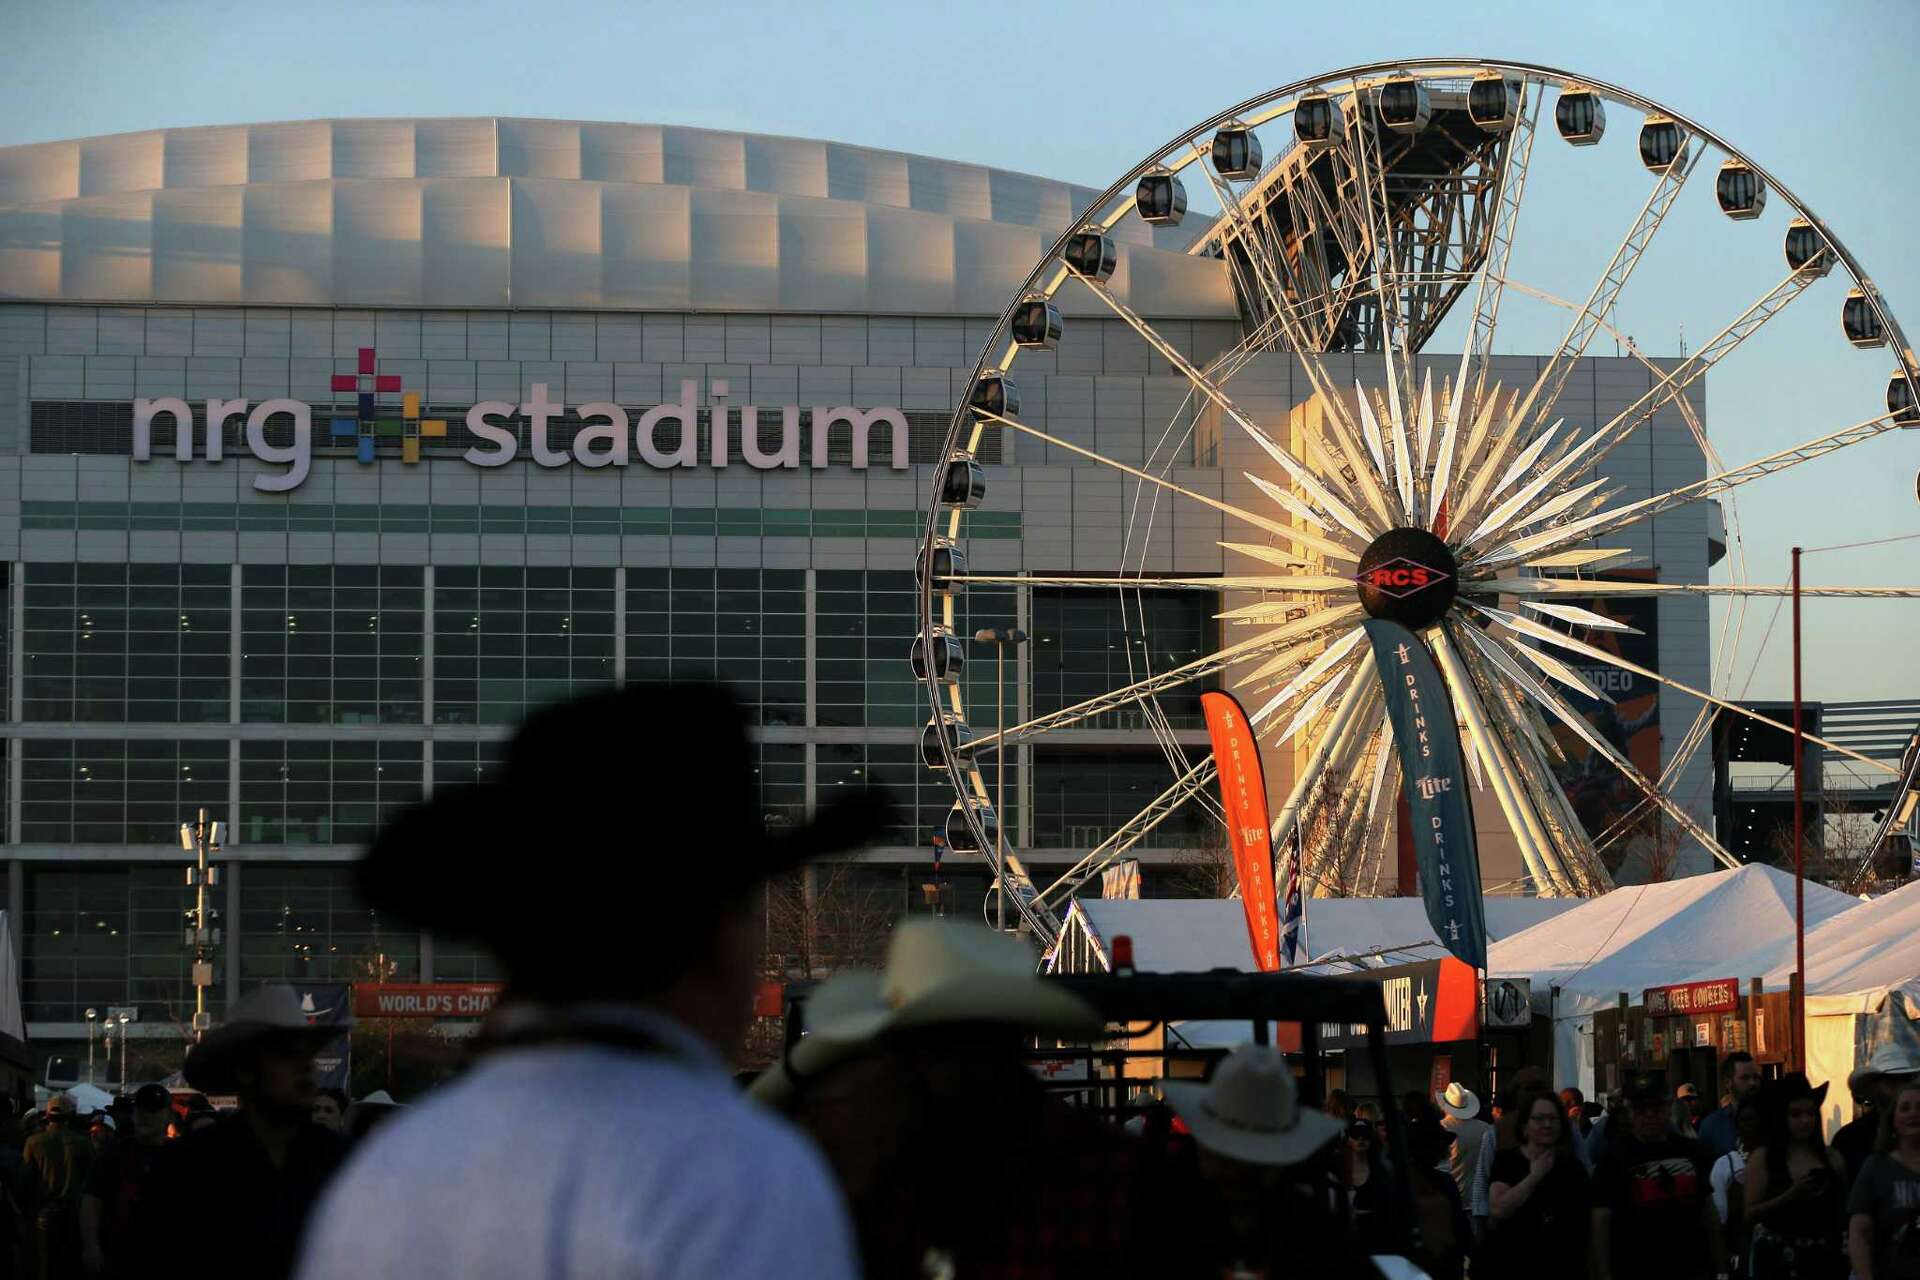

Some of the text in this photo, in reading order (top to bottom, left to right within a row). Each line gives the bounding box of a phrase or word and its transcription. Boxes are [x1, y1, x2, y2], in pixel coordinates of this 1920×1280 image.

[131, 379, 909, 492] nrg stadium
[1371, 568, 1429, 586] RCS
[1581, 670, 1633, 692] ODEO
[1405, 674, 1430, 757] DRINKS
[1230, 737, 1249, 810] DRINKS
[1415, 775, 1451, 800] Lite
[1240, 825, 1265, 847] Lite
[1431, 816, 1454, 907] DRINKS
[1252, 861, 1270, 940] DRINKS
[378, 994, 496, 1013] WORLD'S CHA
